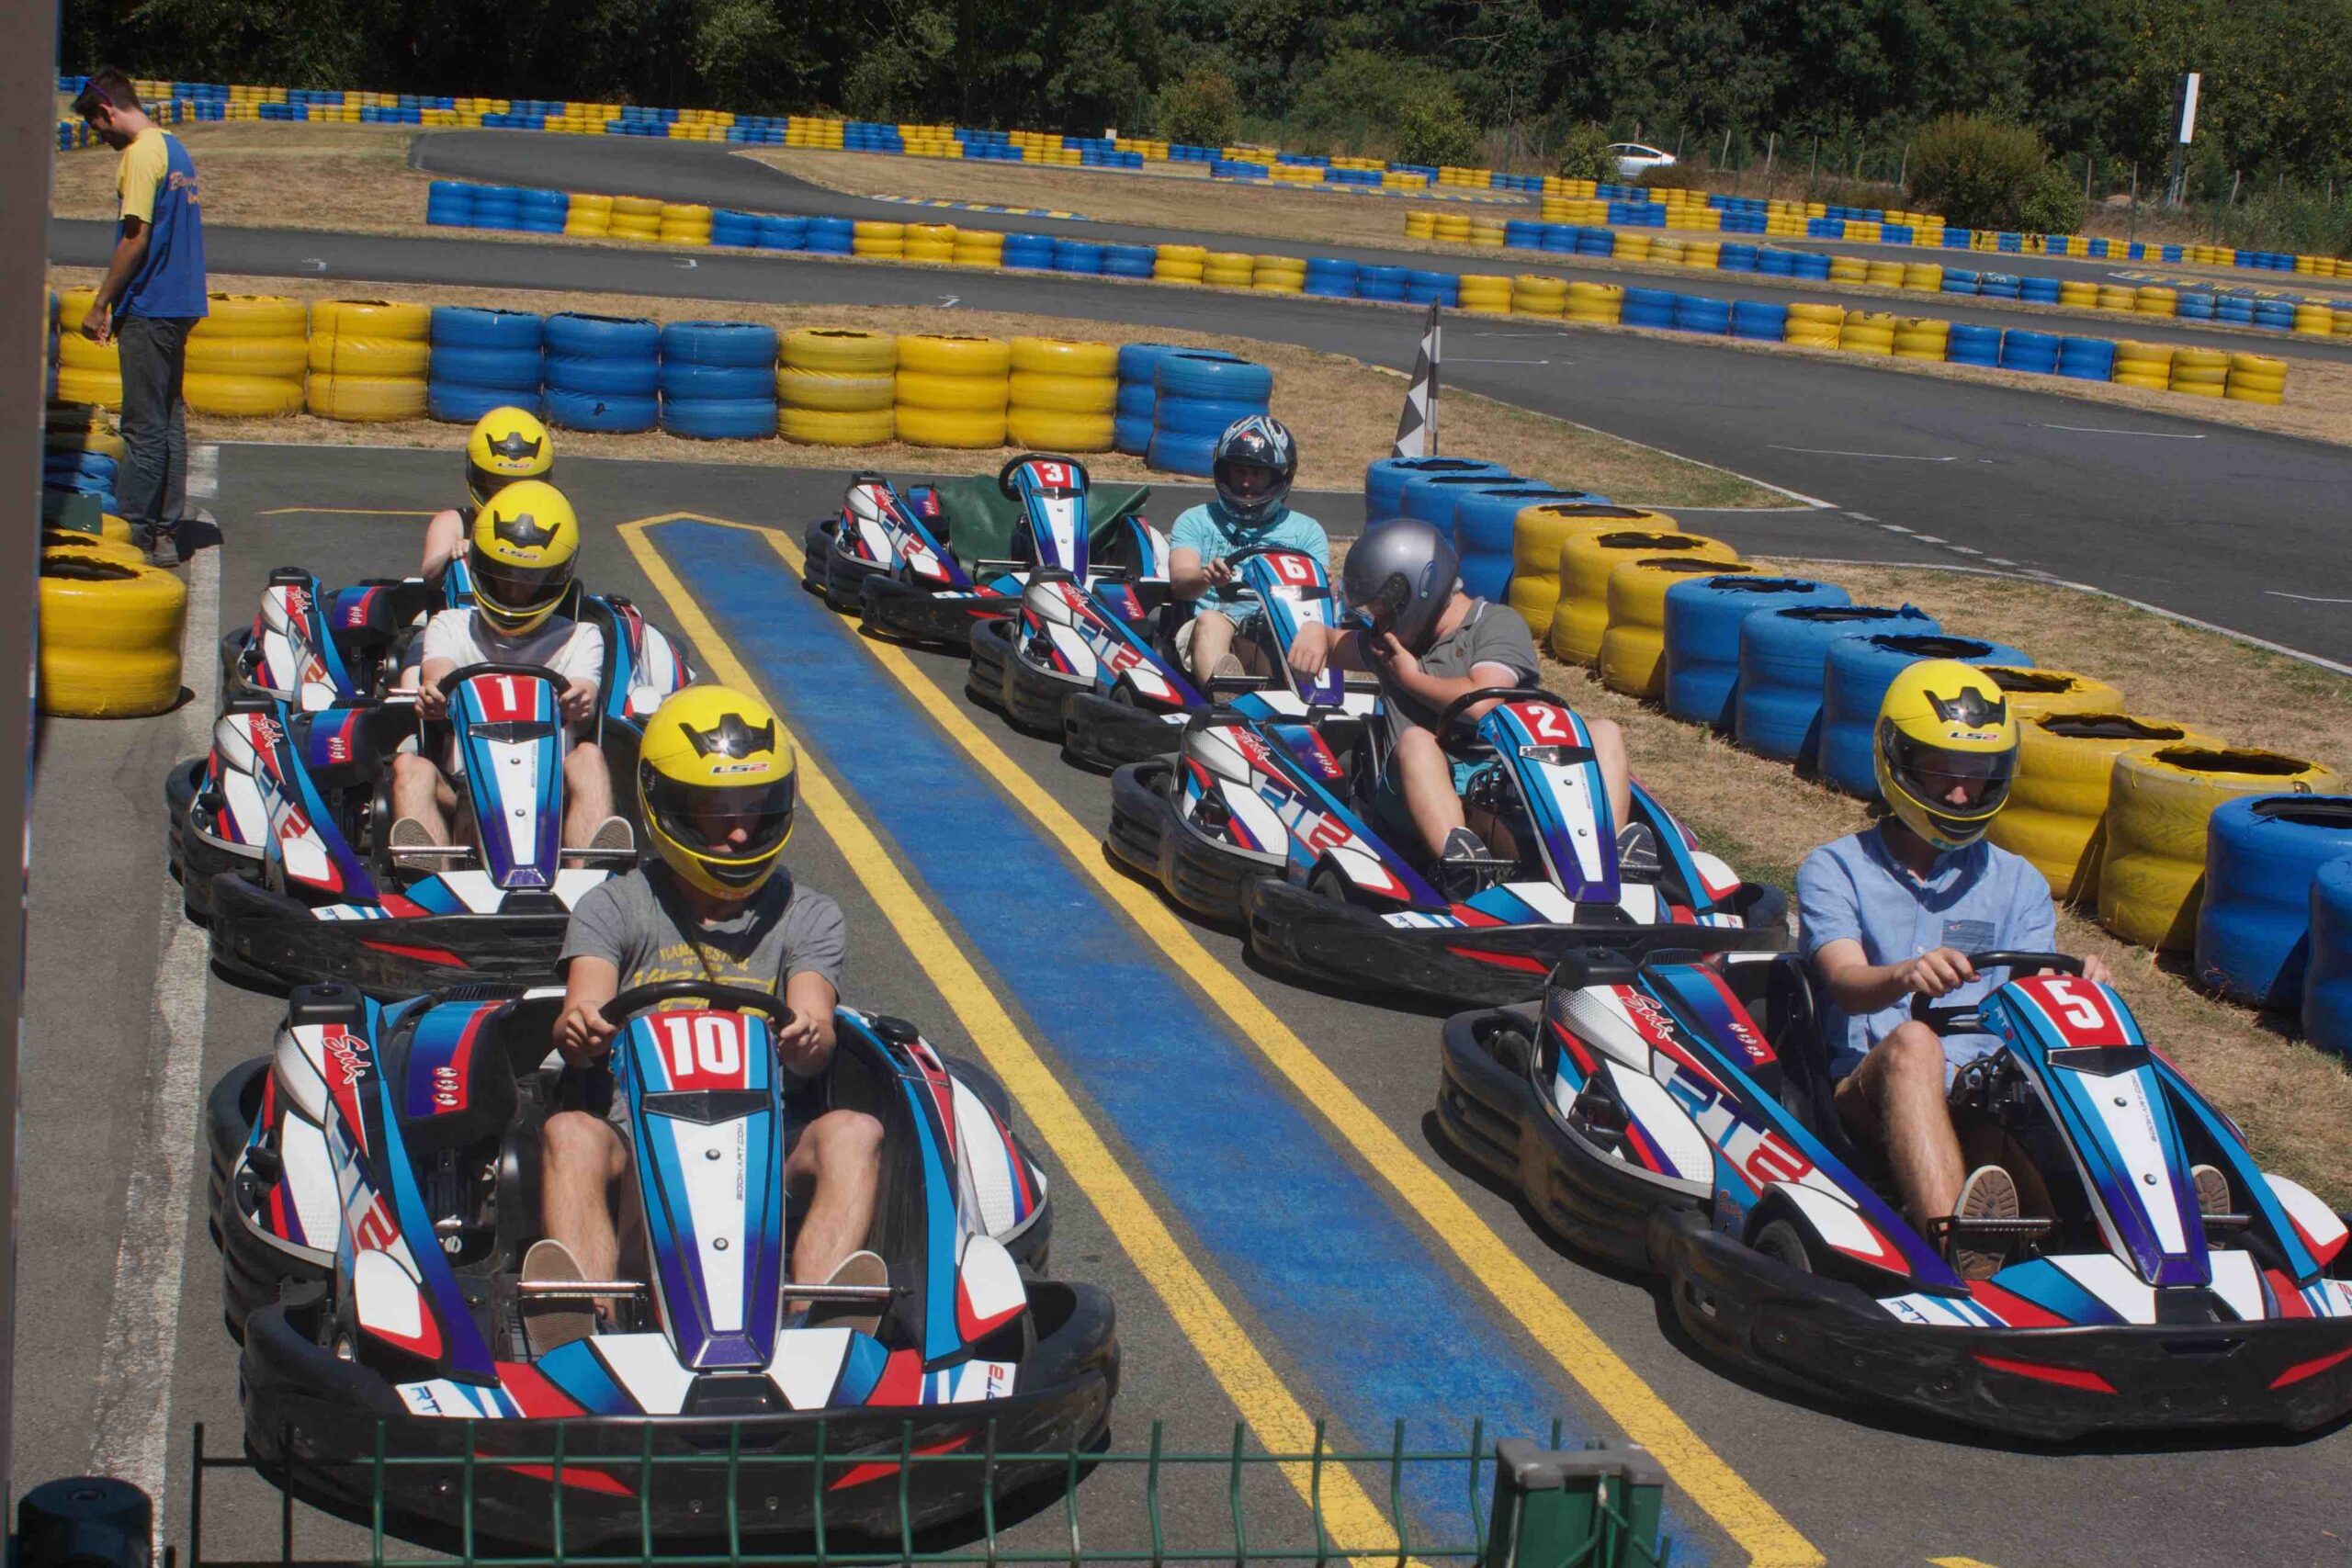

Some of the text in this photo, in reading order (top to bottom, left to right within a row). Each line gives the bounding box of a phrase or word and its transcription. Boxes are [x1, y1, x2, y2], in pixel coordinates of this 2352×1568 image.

[1043, 463, 1064, 482] 3
[1279, 555, 1307, 580] 6
[496, 675, 517, 711] 1
[1526, 705, 1567, 738] 2
[1950, 732, 1998, 740] LS2
[712, 763, 768, 774] LS2
[1619, 994, 1674, 1039] Sodi
[2041, 980, 2104, 1029] 5
[322, 1034, 370, 1085] Sodi
[663, 1016, 741, 1077] 10
